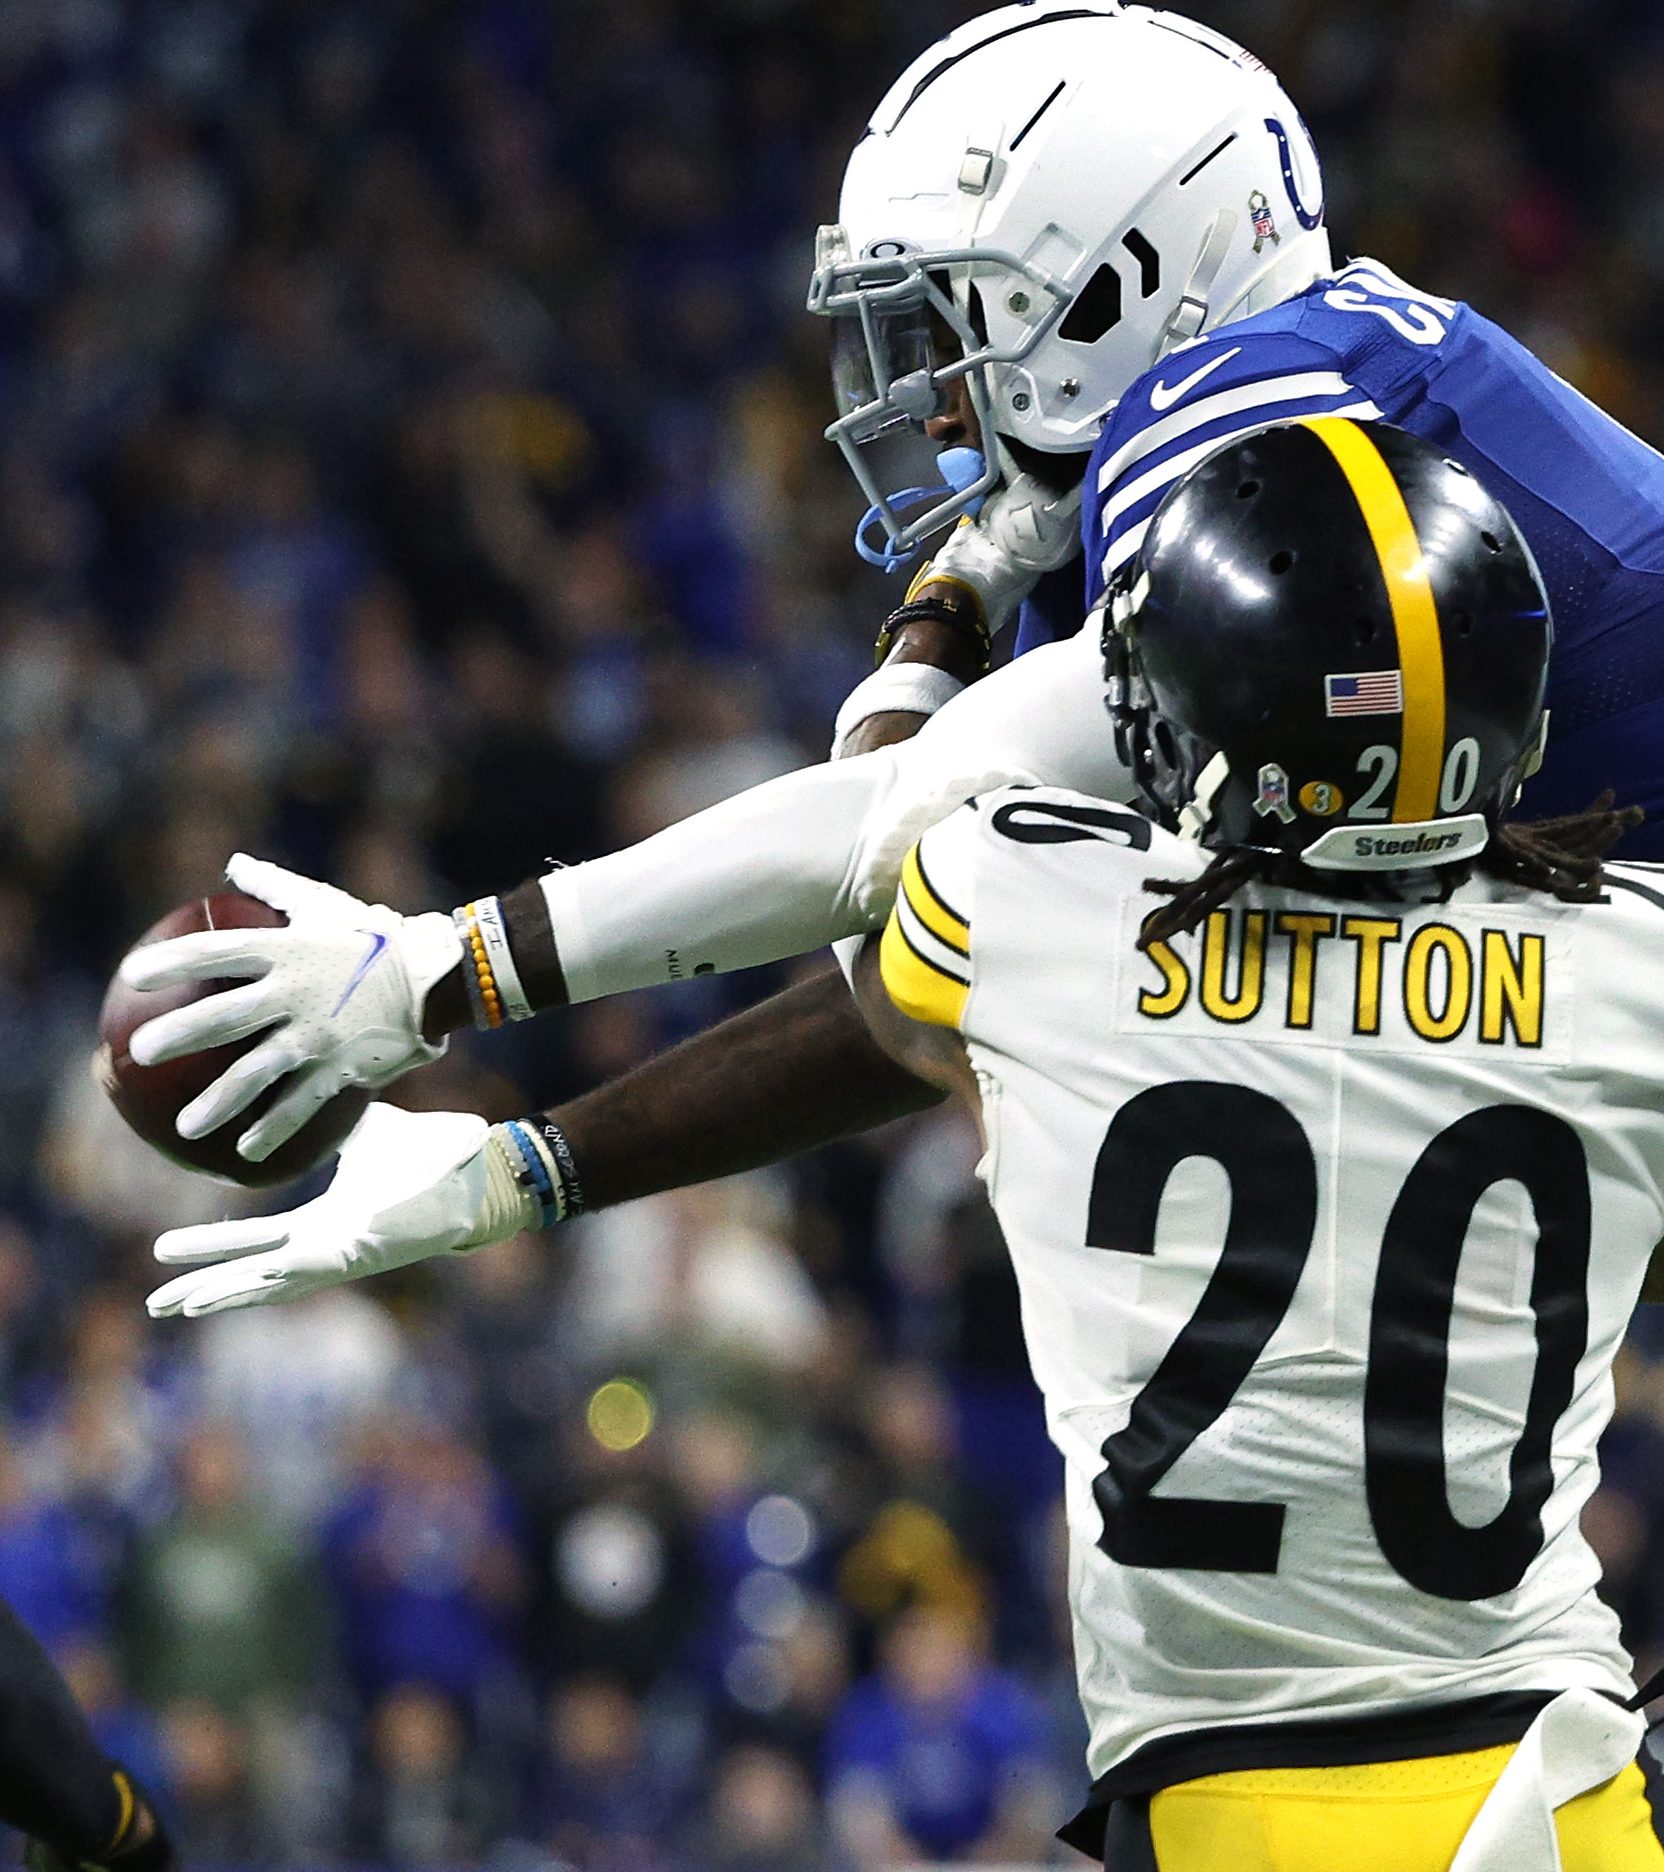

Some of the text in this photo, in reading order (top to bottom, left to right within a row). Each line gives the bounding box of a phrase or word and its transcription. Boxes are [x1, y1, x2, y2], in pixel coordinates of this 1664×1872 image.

[1312, 785, 1331, 812] 3
[1355, 832, 1463, 857] Steelers
[1137, 908, 1546, 1048] SUTTON
[1086, 1080, 1592, 1602] 20
